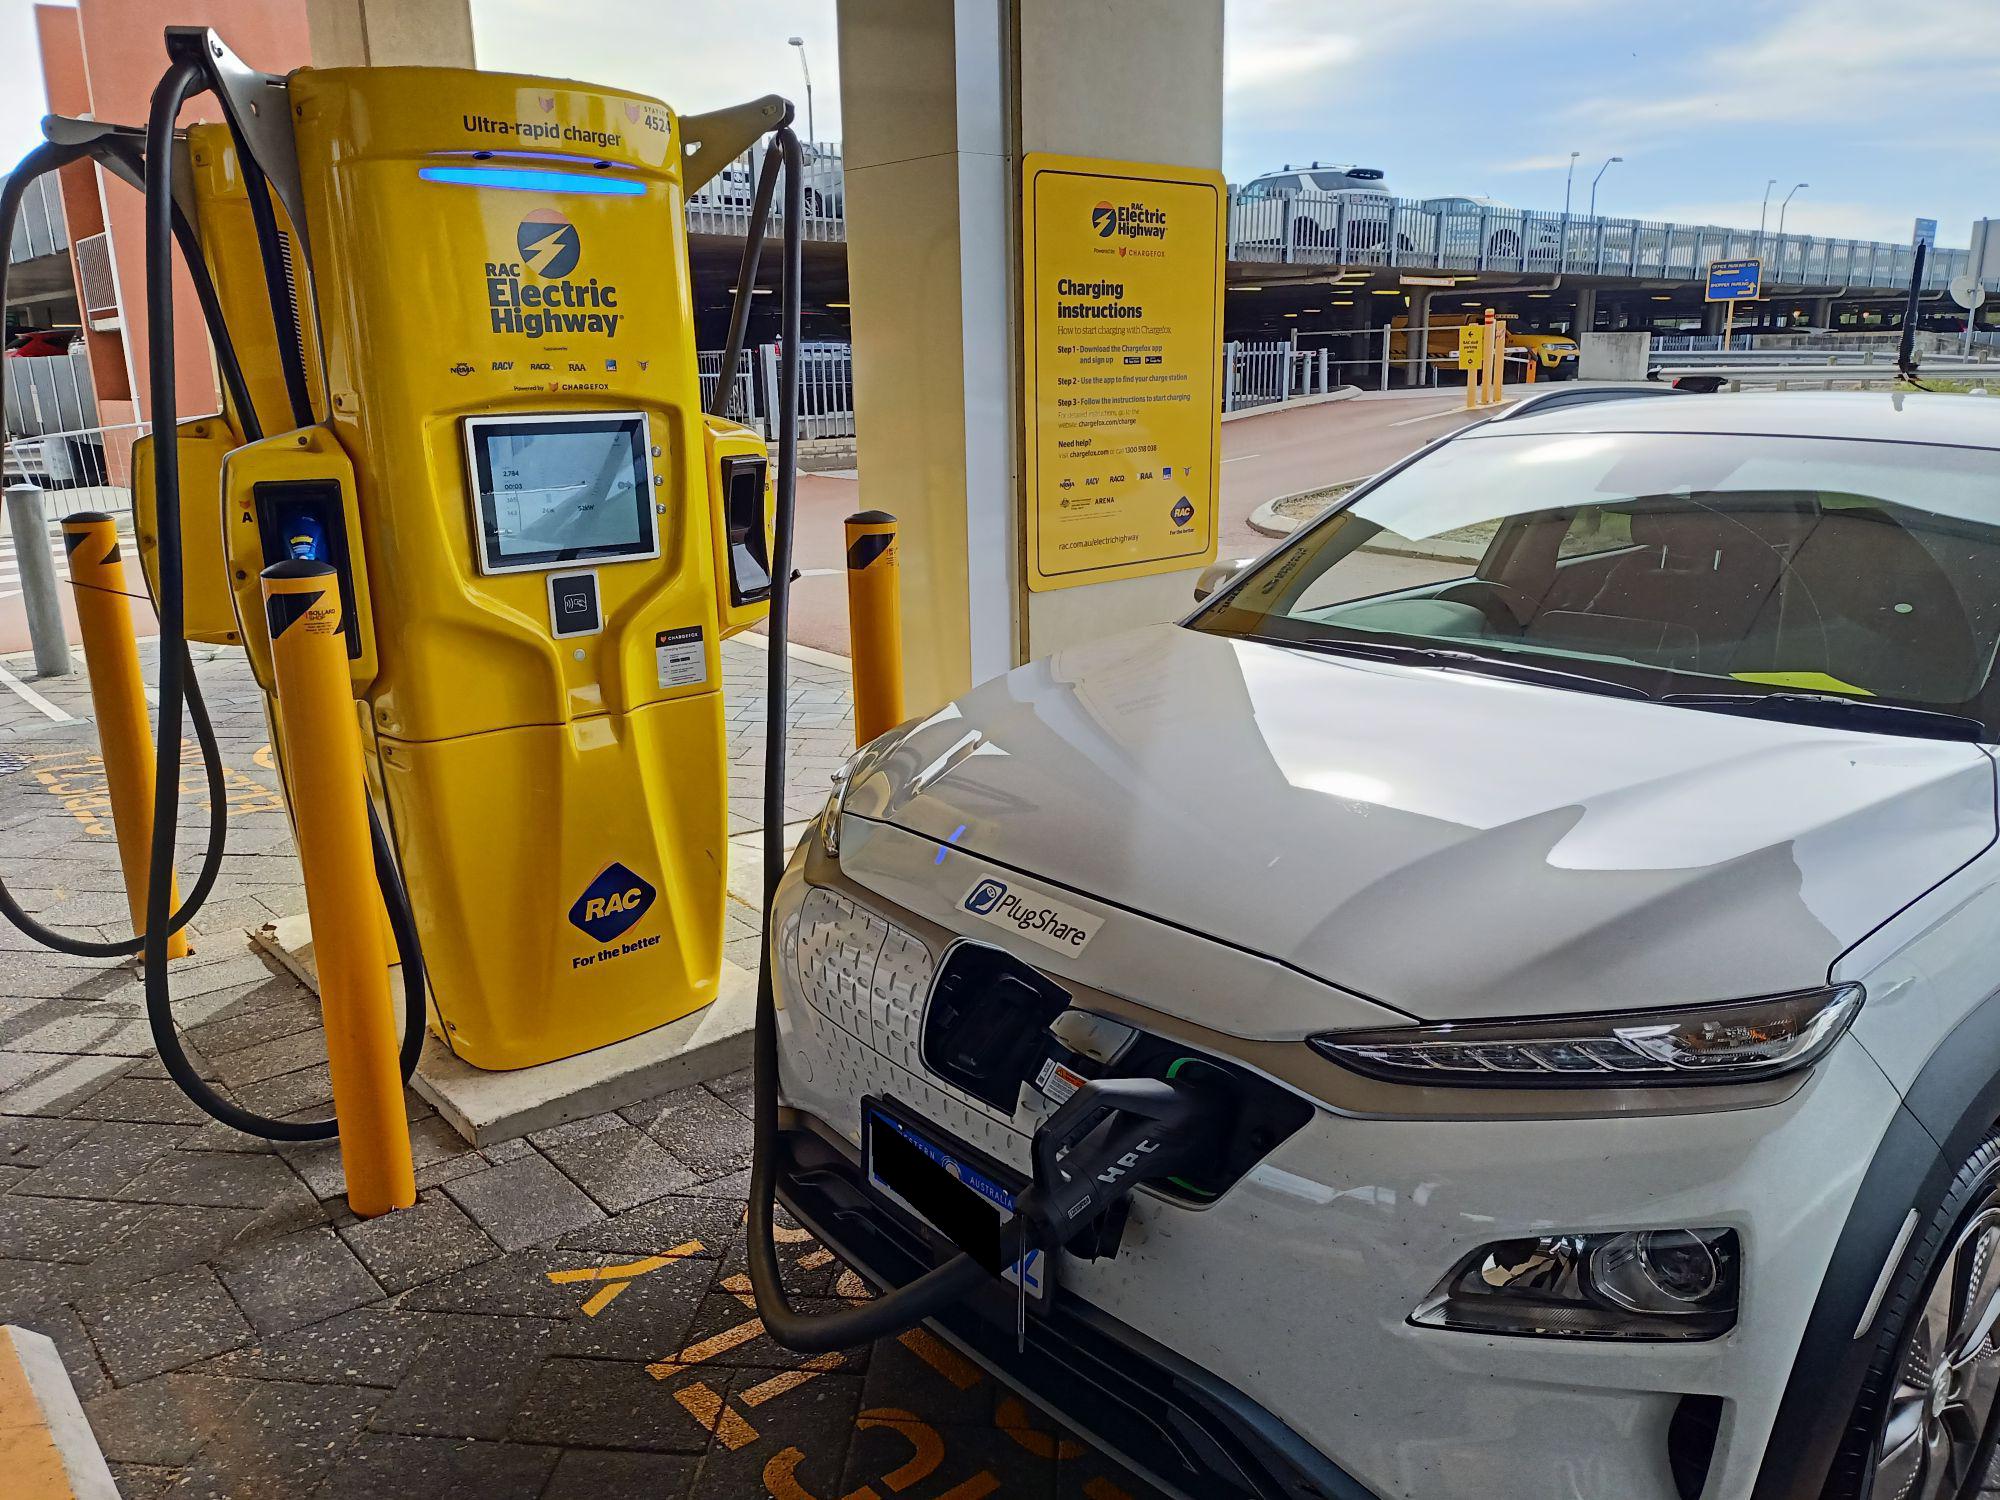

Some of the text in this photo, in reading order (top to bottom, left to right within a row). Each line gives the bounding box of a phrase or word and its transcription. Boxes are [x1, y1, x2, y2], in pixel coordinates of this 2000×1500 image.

[463, 115, 622, 147] Ultra-rapid charger
[645, 115, 672, 134] 4524
[1131, 203, 1144, 211] RAC
[1118, 207, 1166, 224] Electric
[1118, 222, 1166, 239] Highway
[1129, 249, 1165, 257] CHARGEFOX
[485, 262, 520, 277] RAC
[487, 278, 618, 308] Electric
[1057, 279, 1124, 299] Charging
[1057, 302, 1143, 319] instructions
[490, 307, 619, 339] Highway
[1057, 325, 1074, 335] How
[1074, 326, 1081, 335] to
[1082, 326, 1097, 335] start
[1097, 326, 1125, 336] charging
[1126, 325, 1141, 334] with
[1057, 345, 1072, 355] Step
[1079, 345, 1111, 353] Download
[1121, 344, 1151, 353] Chargefox
[1152, 345, 1162, 353] app
[492, 361, 514, 370] RACV
[568, 363, 586, 372] RAA
[1092, 356, 1105, 365] sign
[1105, 356, 1114, 365] up
[562, 382, 609, 391] CHARGEFOX
[1057, 377, 1073, 387] Step
[1092, 376, 1102, 384] the
[1103, 376, 1115, 385] app
[1122, 375, 1135, 383] find
[1135, 375, 1148, 384] your
[1149, 374, 1168, 383] charge
[1168, 373, 1188, 381] station
[1057, 398, 1073, 408] Step
[1080, 397, 1101, 405] Follow
[1101, 396, 1111, 404] the
[1111, 395, 1146, 404] instructions
[1152, 394, 1166, 402] start
[1165, 393, 1191, 402] charging
[1058, 439, 1092, 448] Need help?
[1069, 449, 1109, 459] chargefox.com
[1140, 472, 1153, 480] RAA
[1095, 497, 1115, 505] ARENA
[242, 512, 253, 523] A
[1173, 507, 1191, 518] RAC
[1058, 533, 1139, 550] rac.com.au/electrichighway
[584, 887, 642, 922] RAC
[995, 894, 1087, 946] PlugShare
[572, 933, 661, 969] For the better
[1097, 1139, 1161, 1183] HPC
[969, 1175, 1014, 1211] AUSTRALIA
